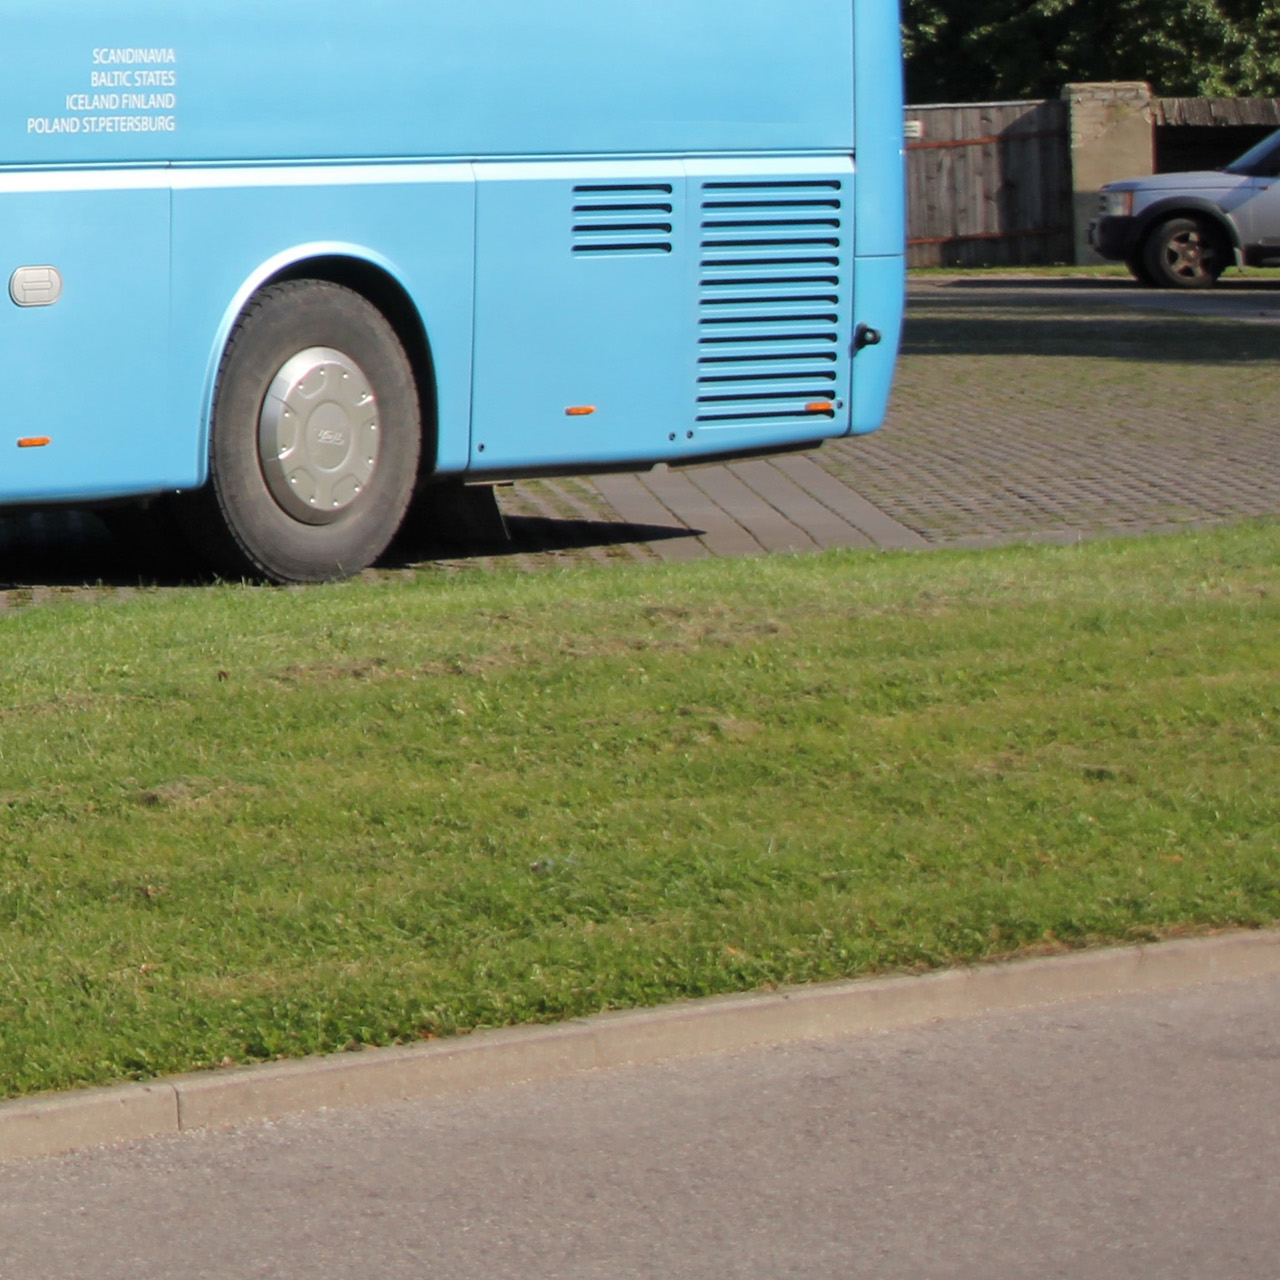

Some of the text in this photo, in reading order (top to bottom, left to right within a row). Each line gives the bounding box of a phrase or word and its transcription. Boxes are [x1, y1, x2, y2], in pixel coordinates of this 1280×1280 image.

[92, 48, 176, 64] SCANDINAVIA
[91, 70, 176, 87] BALTIC STATES
[66, 92, 176, 110] ICELAND FINLAND
[27, 115, 176, 134] POLAND ST.PETERSBURG
